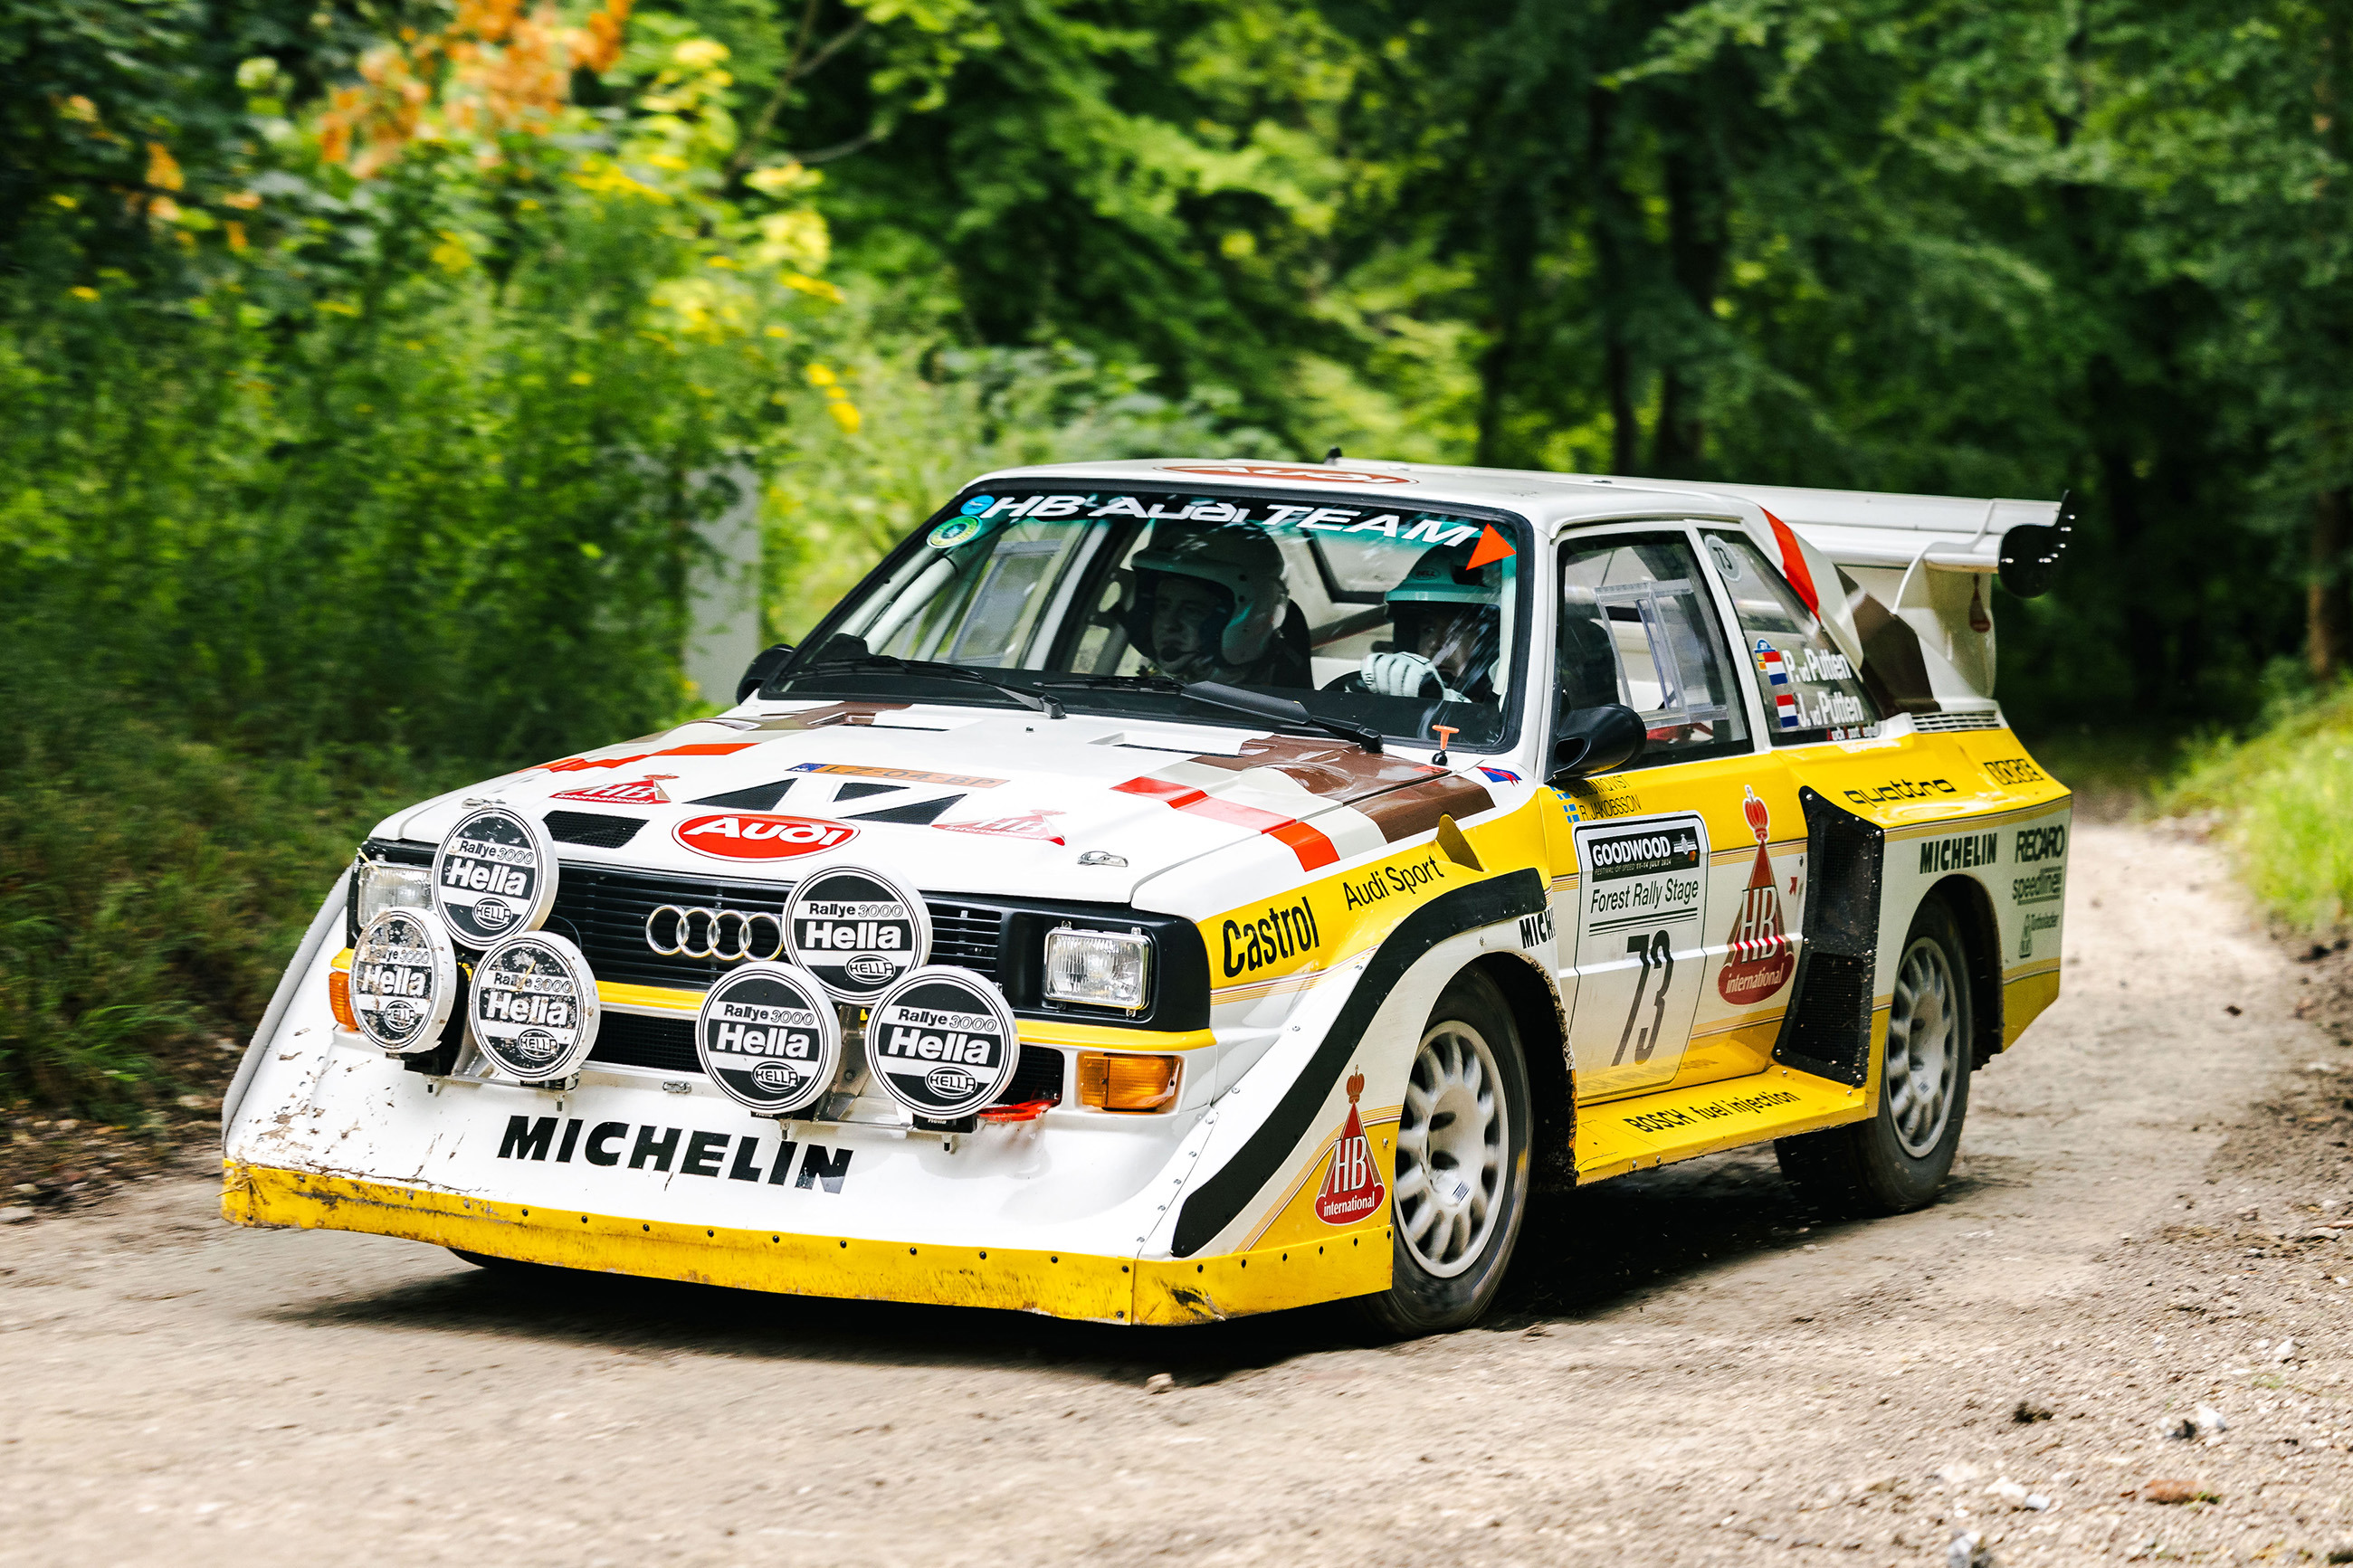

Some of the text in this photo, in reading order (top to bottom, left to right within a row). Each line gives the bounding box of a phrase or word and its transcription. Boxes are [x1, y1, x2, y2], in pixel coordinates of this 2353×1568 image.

[979, 495, 1087, 518] HB
[1262, 503, 1480, 547] TEAM
[1712, 546, 1733, 570] 73
[555, 793, 653, 804] international
[585, 784, 660, 799] HB
[1843, 778, 1957, 808] quattro
[460, 840, 534, 865] Rallye 3000
[1593, 836, 1671, 867] GOODWOOD
[1920, 832, 1997, 874] MICHELIN
[2015, 823, 2065, 863] RECARO
[446, 857, 528, 897] Hella
[1342, 855, 1445, 911] Audi Sport
[809, 902, 903, 918] Rallye 3000
[1591, 878, 1699, 914] Forest Rally Stage
[475, 906, 511, 923] HELLA
[1740, 885, 1781, 965] HB
[805, 920, 901, 950] Hella
[1223, 896, 1320, 978] Castrol
[399, 949, 430, 965] 3000
[849, 961, 895, 975] HELLA
[362, 965, 425, 996] Hella
[534, 978, 572, 994] 3000
[1725, 962, 1784, 994] international
[486, 990, 568, 1026] Hella
[1612, 929, 1674, 1067] 73
[724, 1003, 814, 1026] Rallye 3000
[898, 1007, 997, 1032] Rallye 3000
[521, 1036, 557, 1051] HELLA
[716, 1023, 810, 1059] Hella
[888, 1027, 992, 1065] Hella
[756, 1069, 800, 1085] HELLA
[929, 1073, 976, 1092] HELLA
[1623, 1089, 1802, 1133] BOSCH fuel injection
[497, 1115, 854, 1194] MICHELIN
[1334, 1135, 1367, 1194] HB
[1323, 1194, 1376, 1217] international
